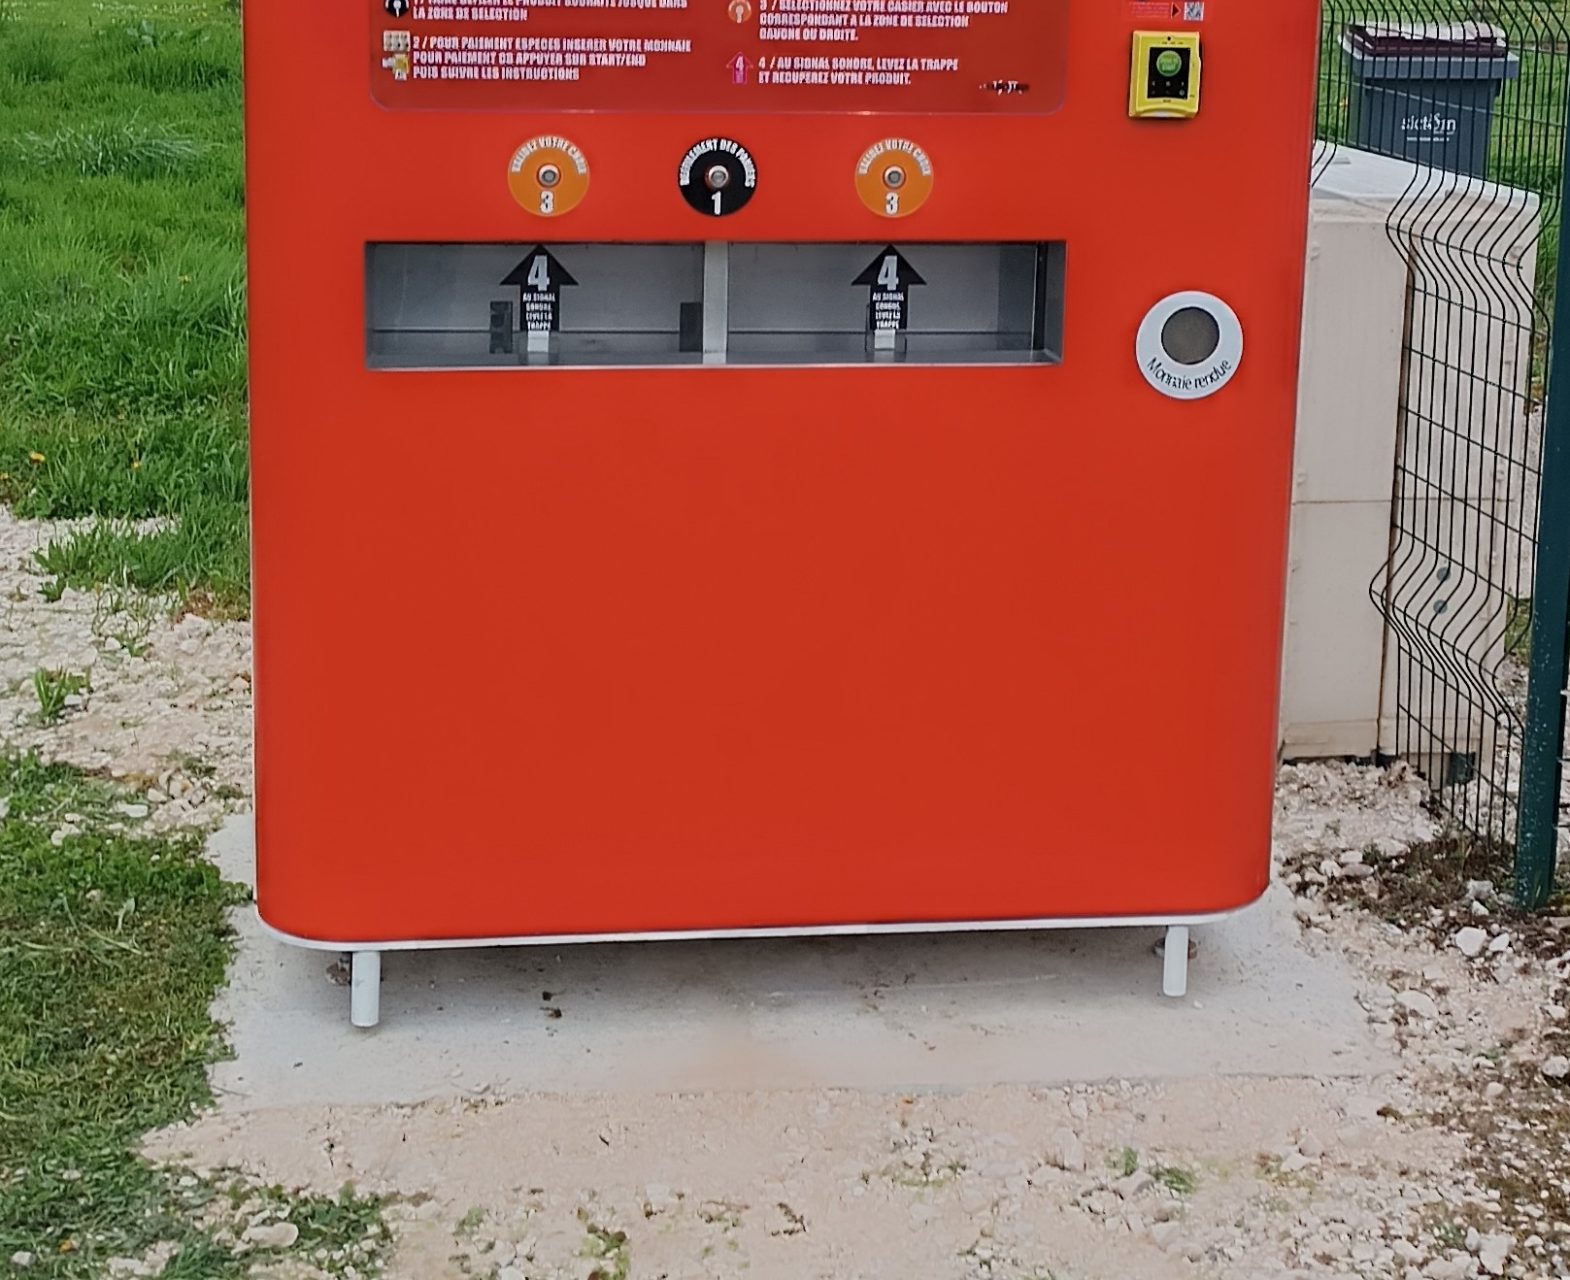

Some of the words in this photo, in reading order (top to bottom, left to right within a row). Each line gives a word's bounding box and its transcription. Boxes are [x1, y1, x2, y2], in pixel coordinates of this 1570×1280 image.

[413, 6, 425, 20] LA
[428, 6, 454, 20] ZONE
[456, 6, 470, 20] DE
[471, 7, 528, 21] SELECTION
[852, 0, 886, 12] VOTRE
[925, 1, 952, 13] AVEC
[953, 1, 965, 13] LE
[966, 1, 1008, 14] BOUTON
[759, 13, 849, 27] CORRESPONDANT
[859, 14, 872, 27] LA
[873, 15, 898, 27] ZONE
[900, 15, 914, 27] DE
[915, 15, 969, 28] SELECTION
[759, 27, 801, 40] GAUCHE
[802, 28, 817, 40] OU
[430, 36, 459, 50] POUR
[461, 37, 514, 51] PAIEMENT
[608, 39, 642, 52] VOTRE
[644, 39, 691, 53] MONNAIE
[413, 51, 443, 64] POUR
[444, 51, 496, 65] PAIEMENT
[516, 52, 563, 66] APPUYER
[565, 53, 587, 66] SUR
[777, 57, 791, 70] AU
[793, 57, 830, 70] SIGNAL
[876, 57, 905, 70] LEVEZ
[906, 58, 918, 70] LA
[920, 58, 959, 71] TRAPPE
[413, 66, 438, 79] PUIS
[440, 66, 479, 80] SUIVRE
[481, 67, 499, 80] LES
[501, 67, 580, 81] INSTRUCTIONS
[758, 71, 770, 84] ET
[772, 71, 828, 84] RECUPEREZ
[830, 72, 863, 85] VOTRE
[538, 136, 569, 152] VOTRE
[885, 138, 914, 154] VOTRE
[540, 190, 554, 214] 3
[711, 190, 722, 215] 1
[885, 191, 899, 215] 3
[527, 255, 550, 291] 4
[877, 255, 899, 291] 4
[1147, 356, 1192, 390] Monnaie
[1194, 359, 1232, 389] rendue
